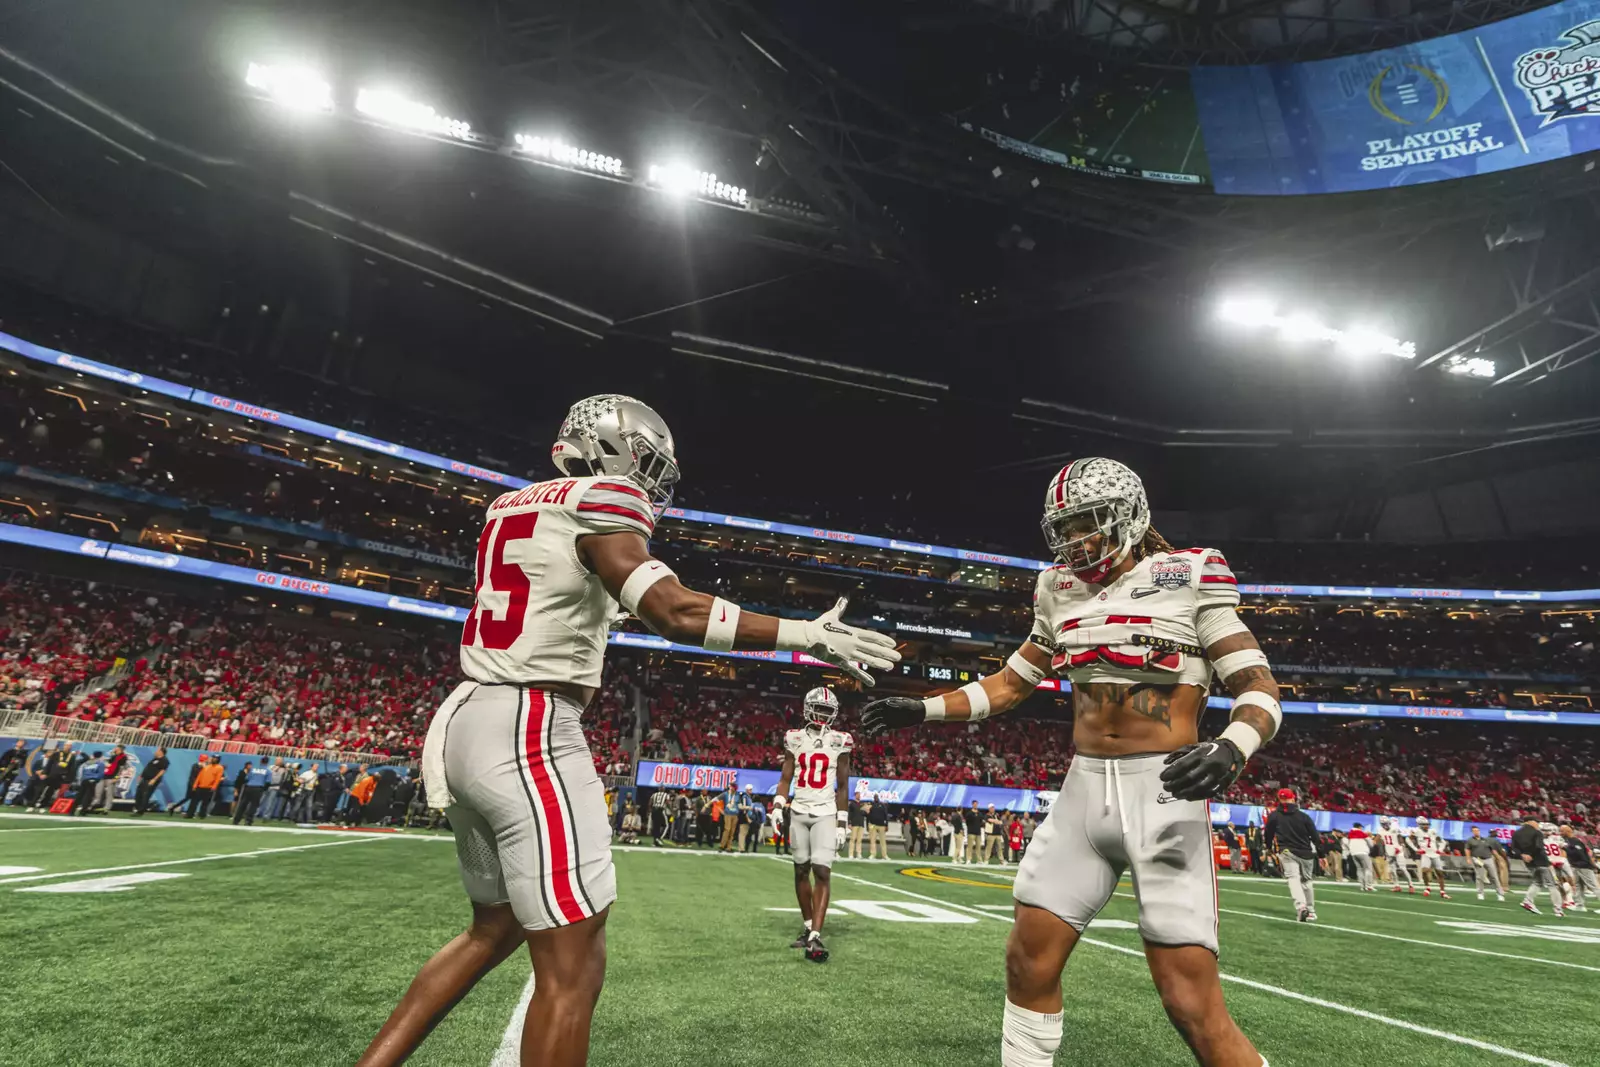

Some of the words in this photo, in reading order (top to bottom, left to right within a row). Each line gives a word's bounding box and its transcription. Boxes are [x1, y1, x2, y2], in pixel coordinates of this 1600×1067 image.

[1366, 122, 1482, 155] PLAYOFF
[1360, 135, 1503, 171] SEMIFINAL
[212, 395, 231, 408] GO
[234, 401, 280, 421] BUCKS
[256, 572, 277, 585] GO
[280, 576, 331, 595] BUCKS
[461, 511, 539, 650] 15
[1152, 572, 1190, 582] PEACH
[896, 622, 944, 635] Mercedes-Benz
[944, 627, 972, 638] Stadium
[929, 667, 952, 680] 36:35
[654, 764, 689, 786] OHIO
[695, 768, 738, 789] STATE
[797, 752, 830, 790] 10
[1384, 835, 1394, 846] 11
[1423, 836, 1432, 849] 7
